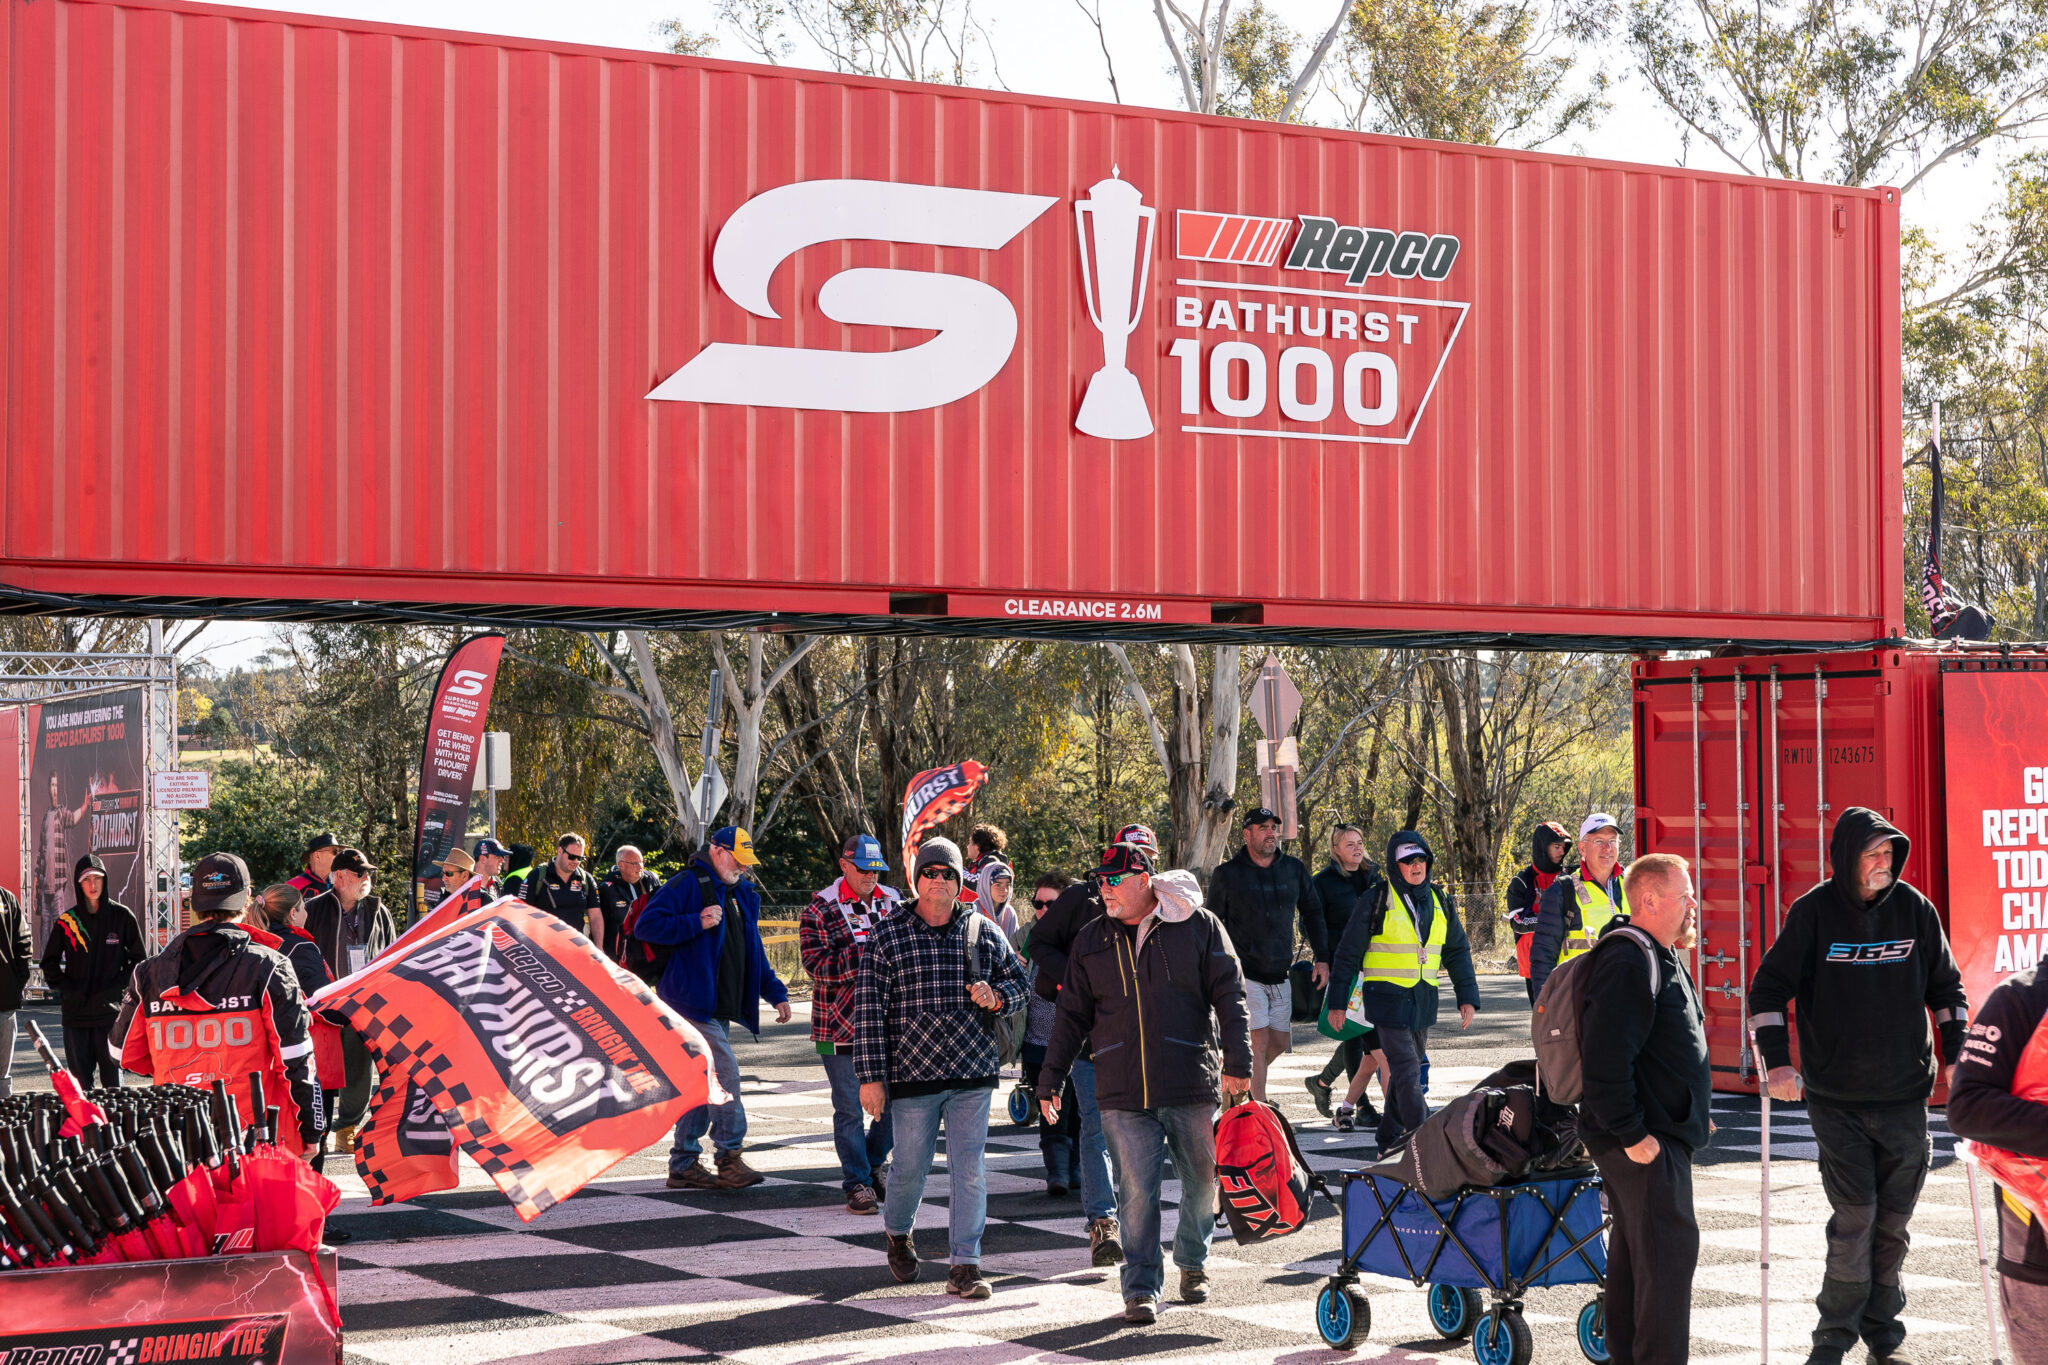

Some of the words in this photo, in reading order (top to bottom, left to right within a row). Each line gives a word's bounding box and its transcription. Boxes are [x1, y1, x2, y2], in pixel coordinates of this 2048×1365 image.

[1284, 214, 1460, 287] Repco
[1176, 296, 1419, 344] BATHURST
[1169, 338, 1398, 426] 1000
[1004, 599, 1116, 618] CLEARANCE
[1120, 602, 1162, 620] 2.6M
[45, 714, 57, 730] YOU
[57, 713, 69, 728] ARE
[69, 711, 83, 727] NOW
[84, 707, 112, 725] ENTERING
[112, 705, 124, 721] THE
[45, 729, 69, 749] REPCO
[69, 724, 107, 747] BATHURST
[107, 721, 125, 741] 1000
[437, 728, 452, 739] GET
[452, 731, 475, 744] BEHIND
[438, 738, 451, 748] THE
[452, 741, 471, 753] WHEEL
[434, 757, 468, 772] FAVOURITE
[435, 747, 453, 758] WITH
[453, 751, 471, 763] YOUR
[1783, 747, 1812, 765] RWTU
[1829, 746, 1874, 765] 1243675
[437, 768, 462, 781] DRIVERS
[92, 810, 138, 852] BATHURST
[502, 943, 566, 994] Repco
[150, 1016, 253, 1051] 1000
[400, 930, 634, 1121] BATHURST
[621, 1061, 661, 1095] THE
[231, 1327, 268, 1356] THE
